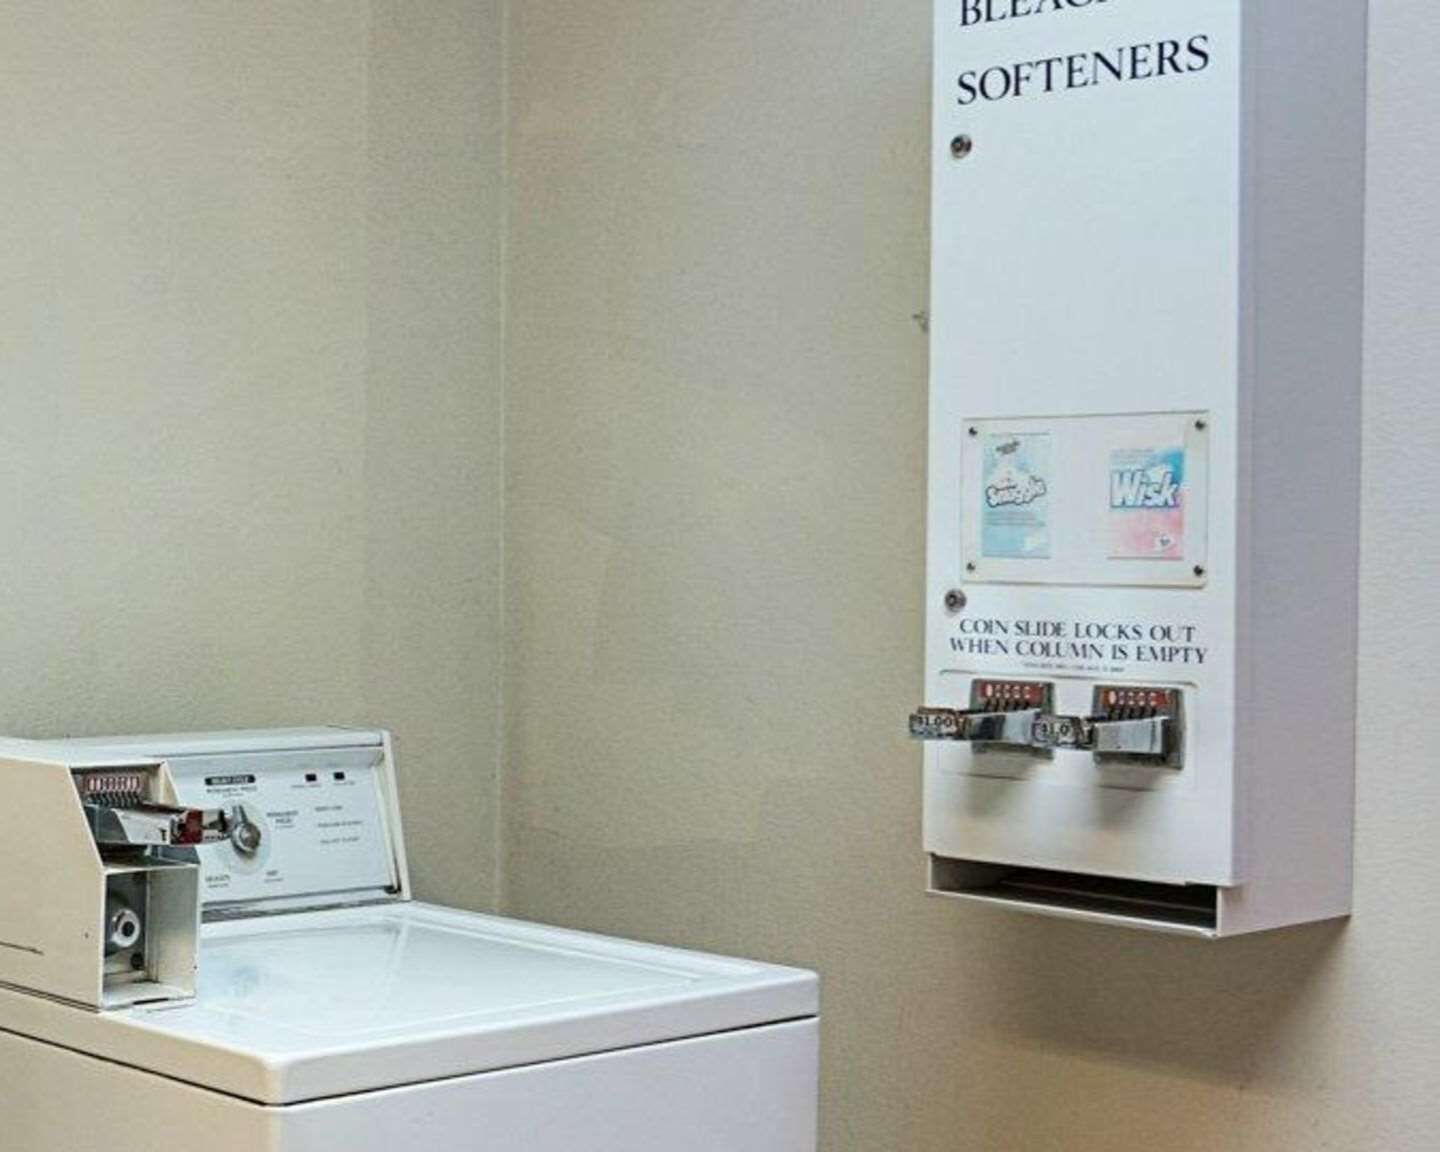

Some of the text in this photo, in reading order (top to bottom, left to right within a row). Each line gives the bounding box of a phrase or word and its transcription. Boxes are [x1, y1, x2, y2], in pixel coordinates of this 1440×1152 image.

[960, 0, 1111, 26] BLE
[956, 34, 1210, 106] SOFTENERS
[1110, 468, 1180, 508] Wisk
[959, 618, 1197, 643] COIN SLIDE LOCKS OUT
[949, 637, 1208, 664] WHEN COLUMN IS EMPTY
